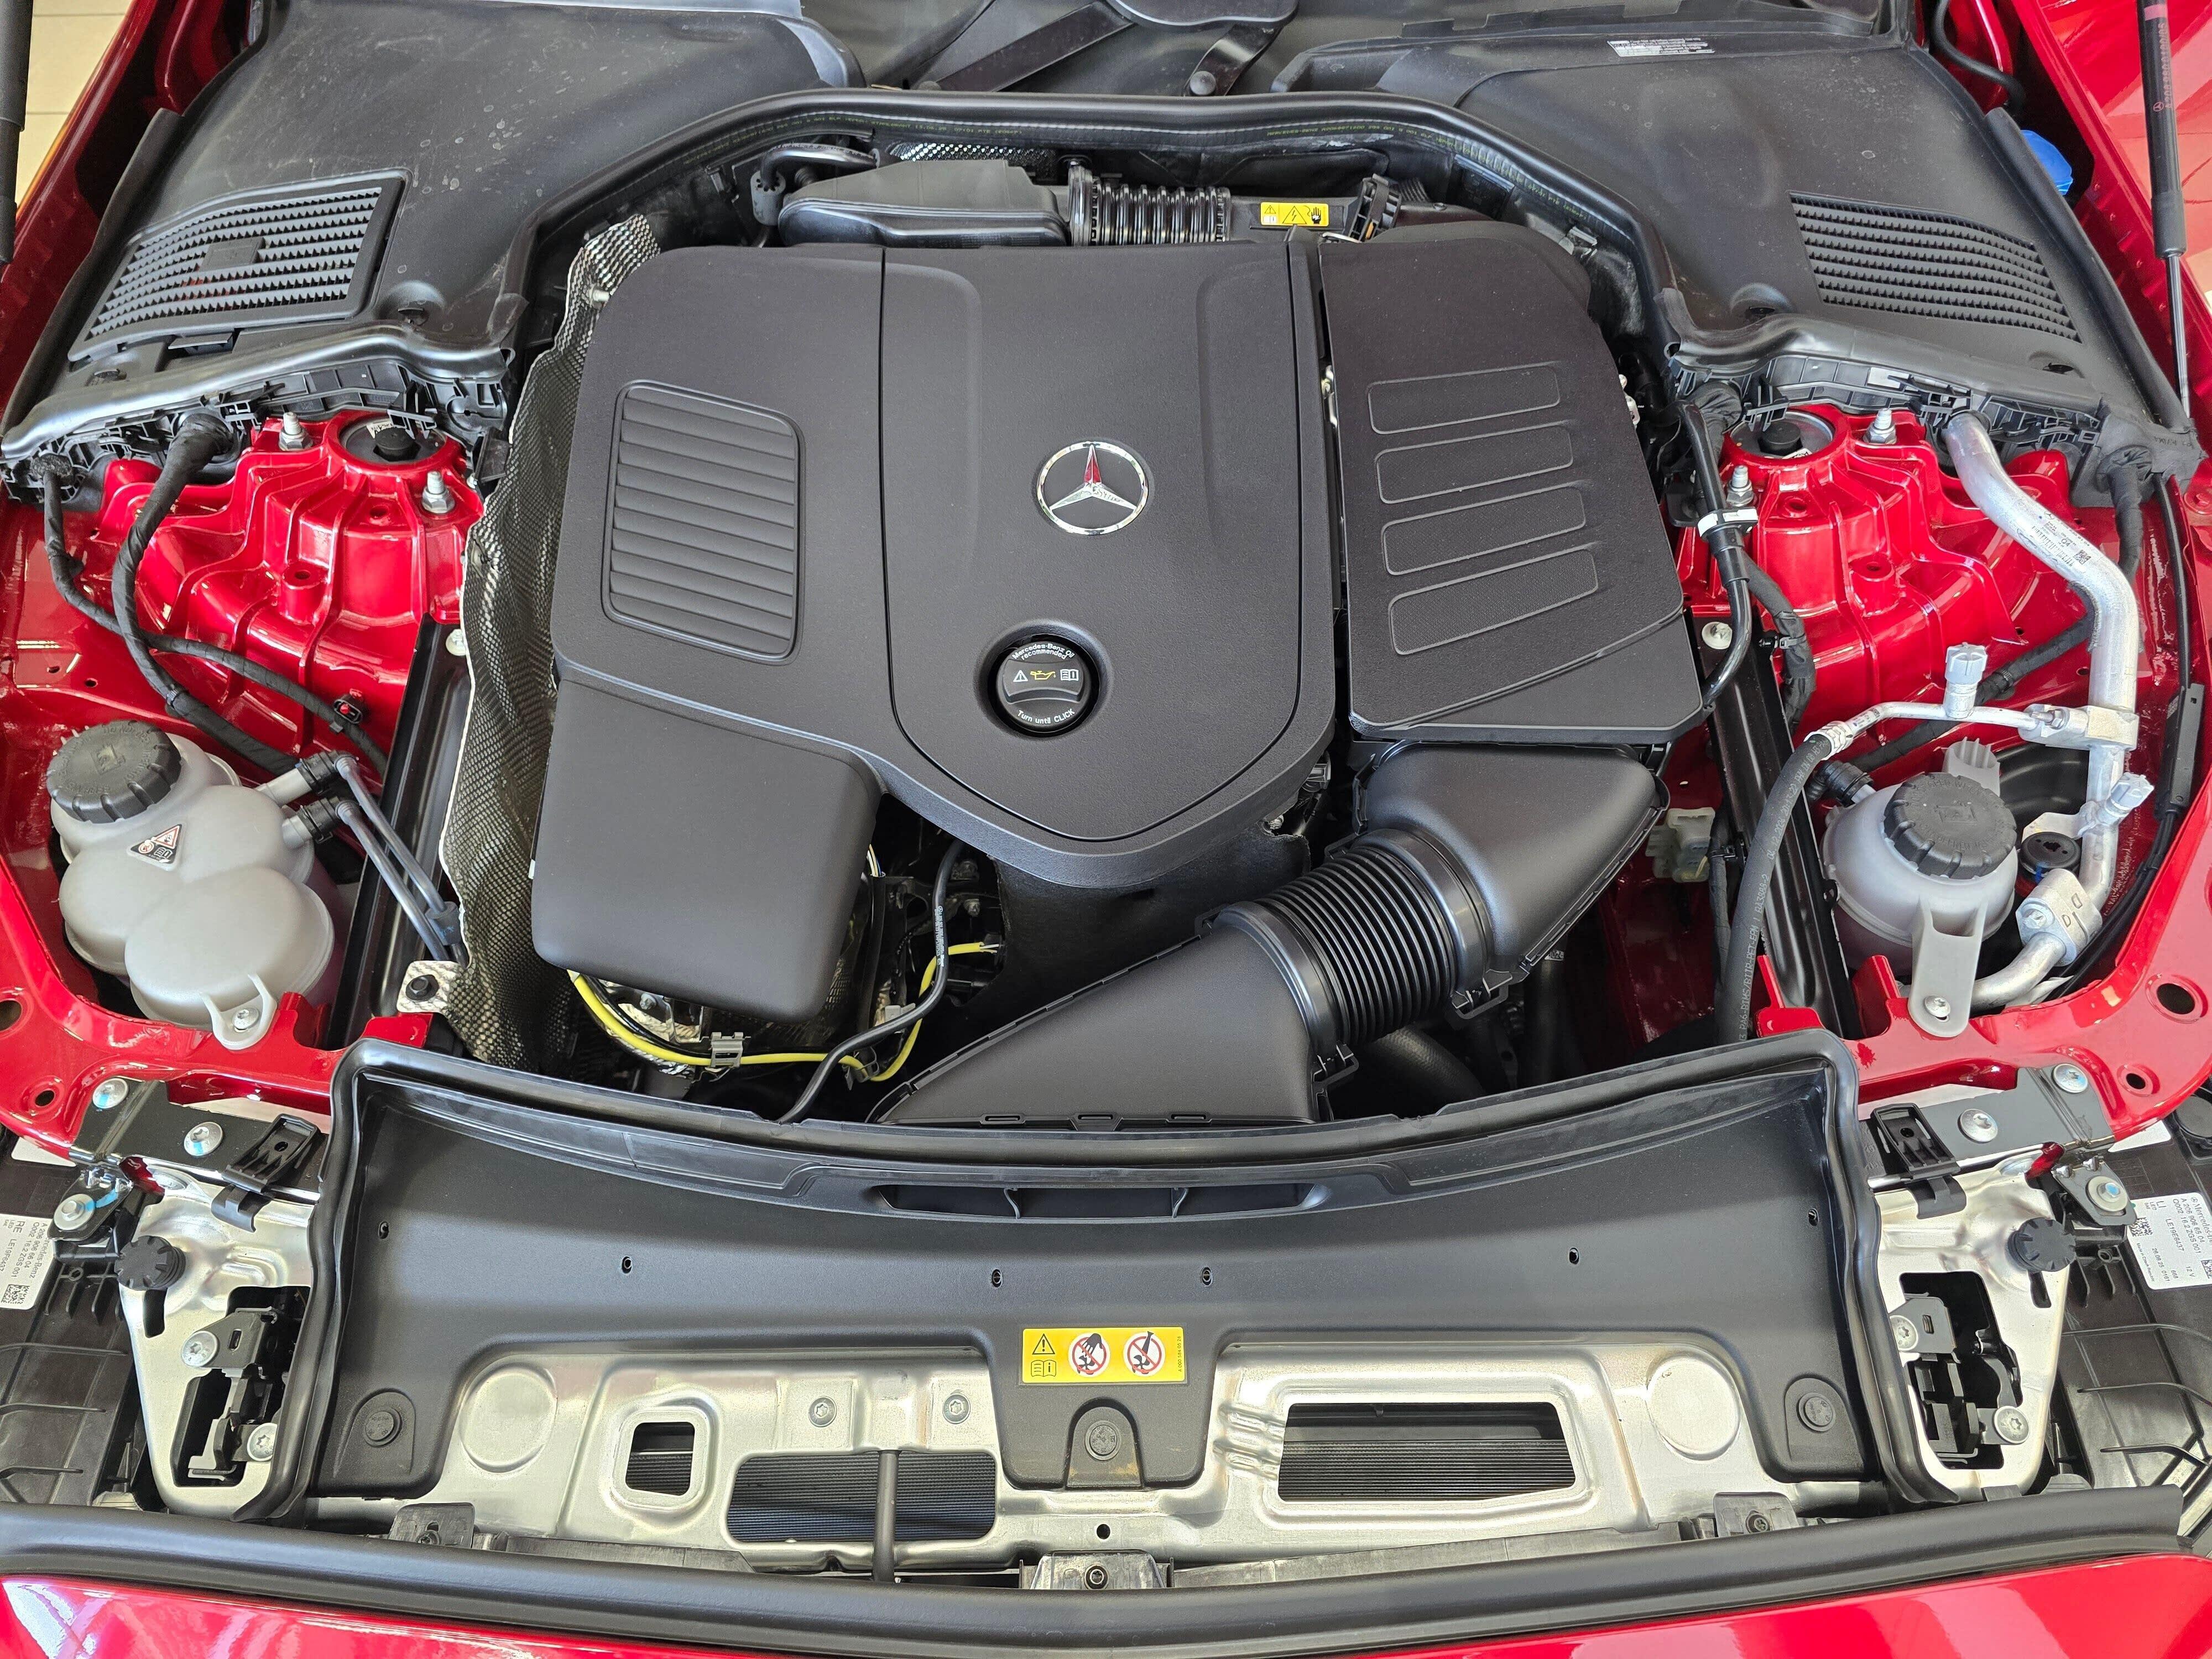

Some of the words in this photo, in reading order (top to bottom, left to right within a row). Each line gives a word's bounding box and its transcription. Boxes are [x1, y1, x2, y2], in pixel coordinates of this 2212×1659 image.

[1012, 643, 1065, 660] Mercedes-Benz
[1066, 649, 1075, 658] Oil
[1021, 649, 1067, 660] recommended
[1018, 710, 1032, 722] Turn
[1054, 708, 1076, 723] CLICK
[2184, 1203, 2192, 1214] 206
[13, 1221, 25, 1233] RE
[29, 1222, 39, 1238] Q002
[2173, 1198, 2183, 1214] Q002
[2187, 1229, 2196, 1243] ZGS
[2193, 1244, 2201, 1254] 001
[36, 1228, 45, 1239] 206
[2166, 1218, 2184, 1251] LE19E6437
[17, 1253, 26, 1266] ZGS
[29, 1237, 50, 1279] ercedes-Benz
[11, 1267, 20, 1278] 001
